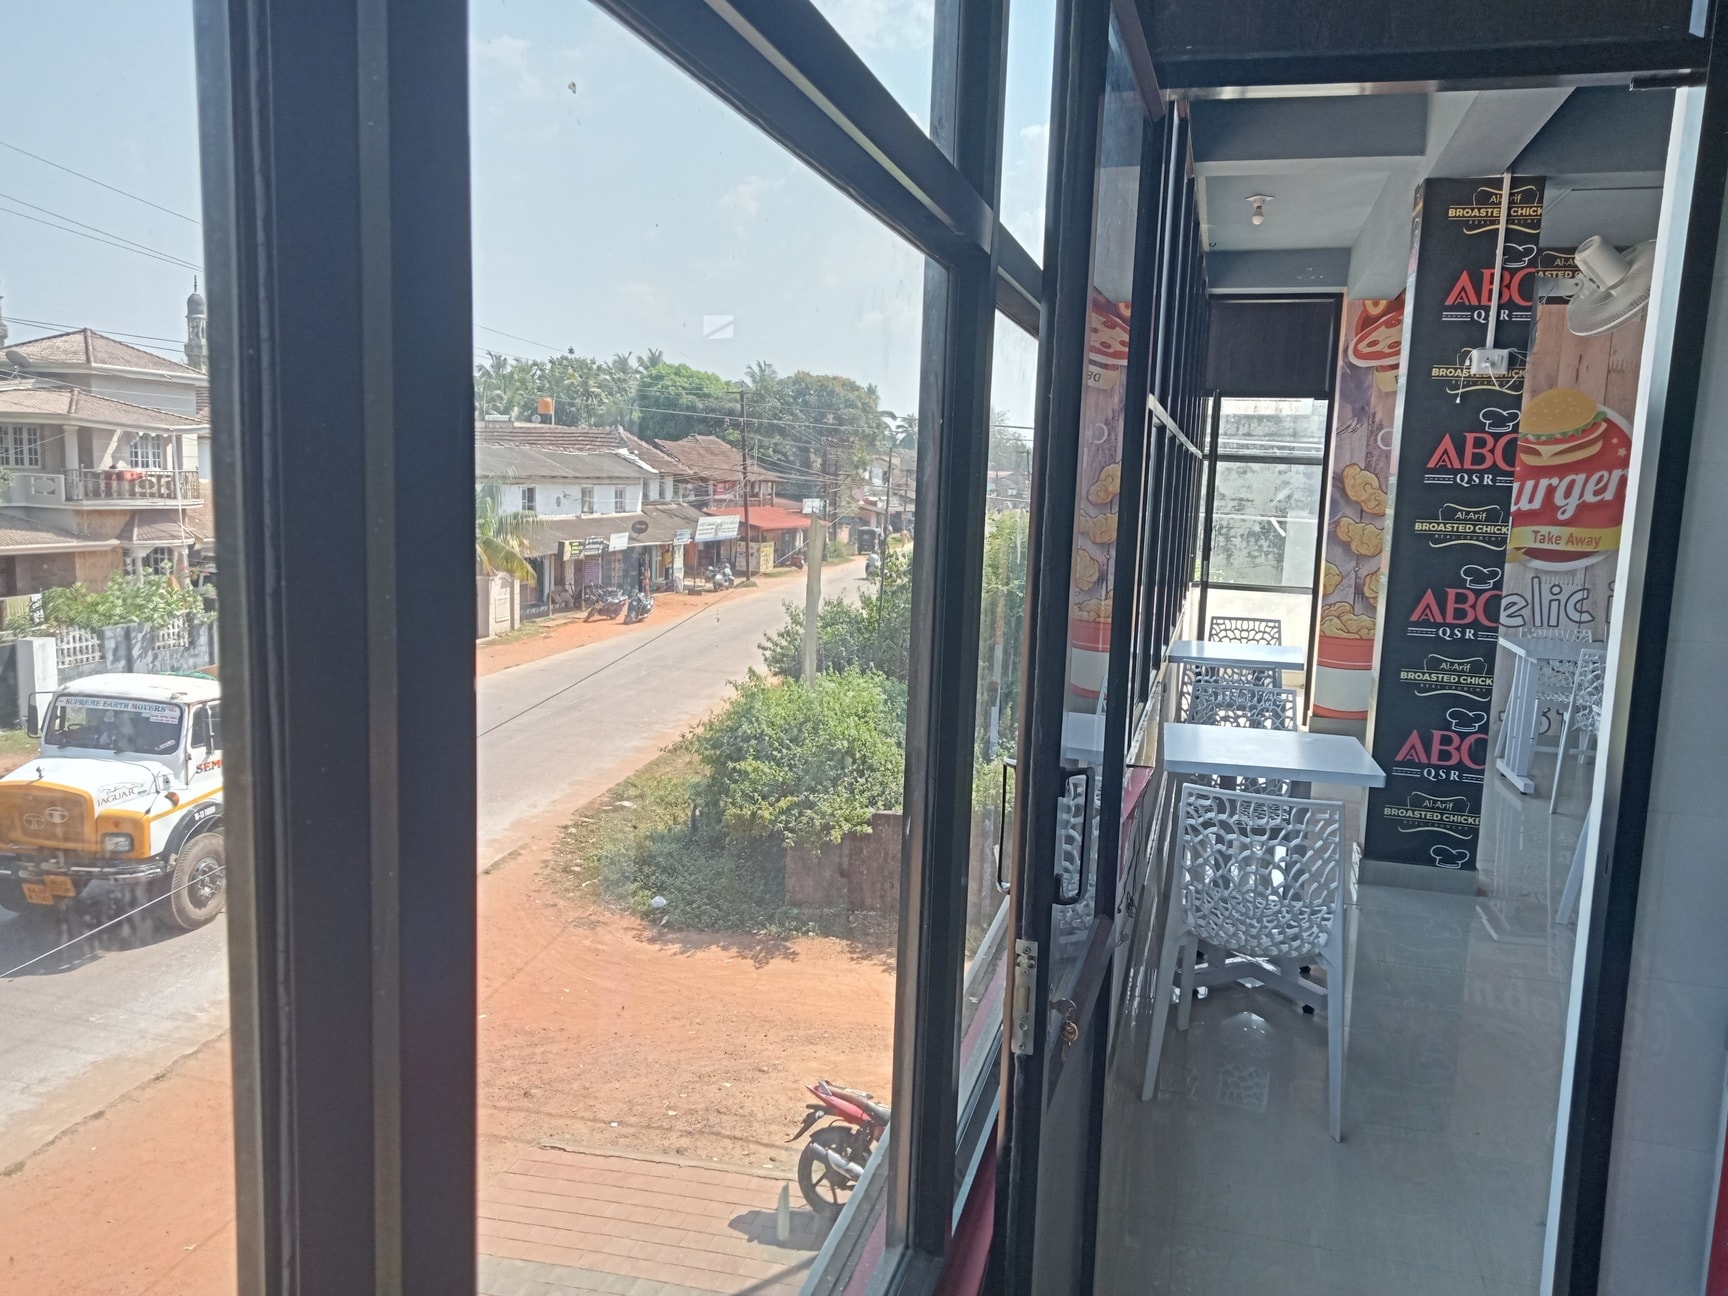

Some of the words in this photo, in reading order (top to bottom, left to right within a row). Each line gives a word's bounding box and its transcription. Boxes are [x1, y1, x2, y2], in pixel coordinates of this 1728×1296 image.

[1489, 193, 1523, 204] Al-rif
[1448, 208, 1501, 217] BROASTE
[1444, 267, 1536, 306] ABC
[1473, 309, 1510, 323] QR
[1426, 432, 1518, 472] ABC
[1456, 473, 1494, 487] QSR
[1454, 511, 1488, 521] Al-Arif
[1414, 522, 1474, 533] BROASTED
[1532, 530, 1562, 545] Take
[1565, 532, 1602, 550] Away
[1408, 587, 1503, 628] ABC
[1438, 626, 1475, 641] QSR
[1439, 662, 1472, 673] Al-Arif
[1400, 671, 1458, 683] BROASTED
[1460, 676, 1494, 686] CHICK
[65, 698, 101, 707] SUPREME
[102, 700, 129, 709] EARTH
[131, 703, 167, 713] MOVERS
[1394, 729, 1489, 770] ABC
[1423, 767, 1460, 781] QSR
[97, 787, 136, 807] JAGUAR
[1422, 799, 1455, 811] Al-Arif
[1383, 807, 1441, 820] BROASTED
